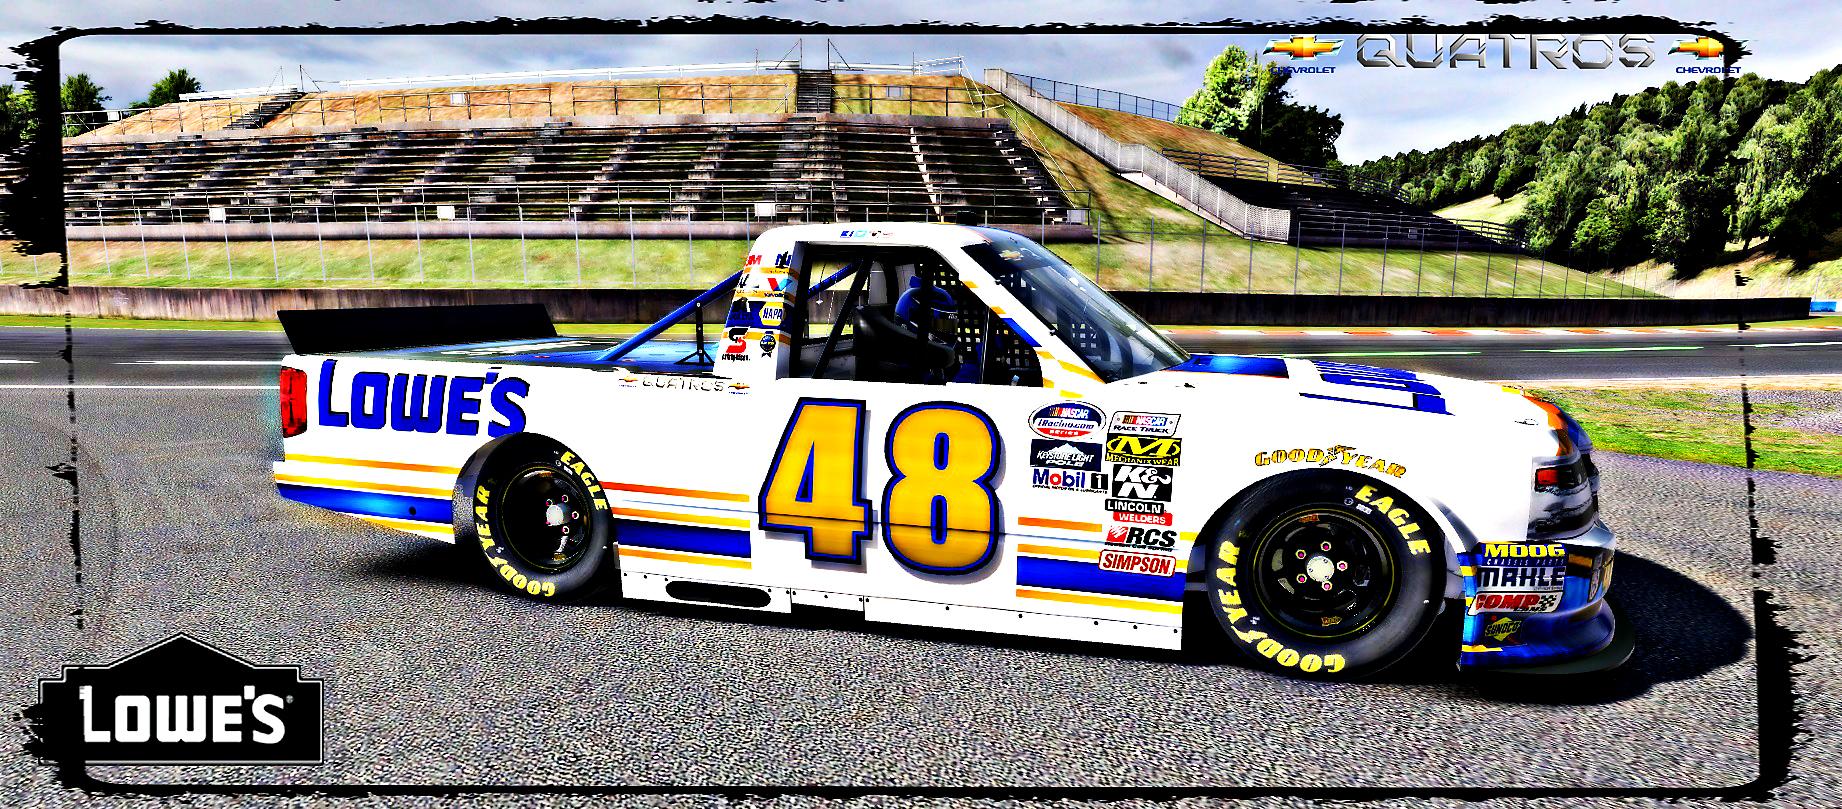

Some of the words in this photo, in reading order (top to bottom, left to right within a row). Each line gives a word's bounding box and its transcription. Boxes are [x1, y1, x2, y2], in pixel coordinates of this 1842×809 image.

[762, 307, 783, 320] NAPA
[318, 359, 530, 438] LOWE'S
[1060, 407, 1089, 419] NASCAR
[1136, 415, 1168, 427] NASCAR
[1140, 426, 1169, 434] TRUCK
[560, 450, 609, 511] EAGLE
[758, 397, 1000, 575] 48
[1033, 468, 1086, 489] Mobil
[1107, 500, 1162, 514] LINCOLN
[1119, 513, 1166, 525] WELDERS
[1354, 484, 1432, 556] EAGLE
[1126, 527, 1178, 547] RCS
[1484, 544, 1566, 558] MOOG
[1103, 552, 1172, 575] SIMPSON
[1477, 567, 1565, 588] MAHLE
[1475, 594, 1541, 610] COMP
